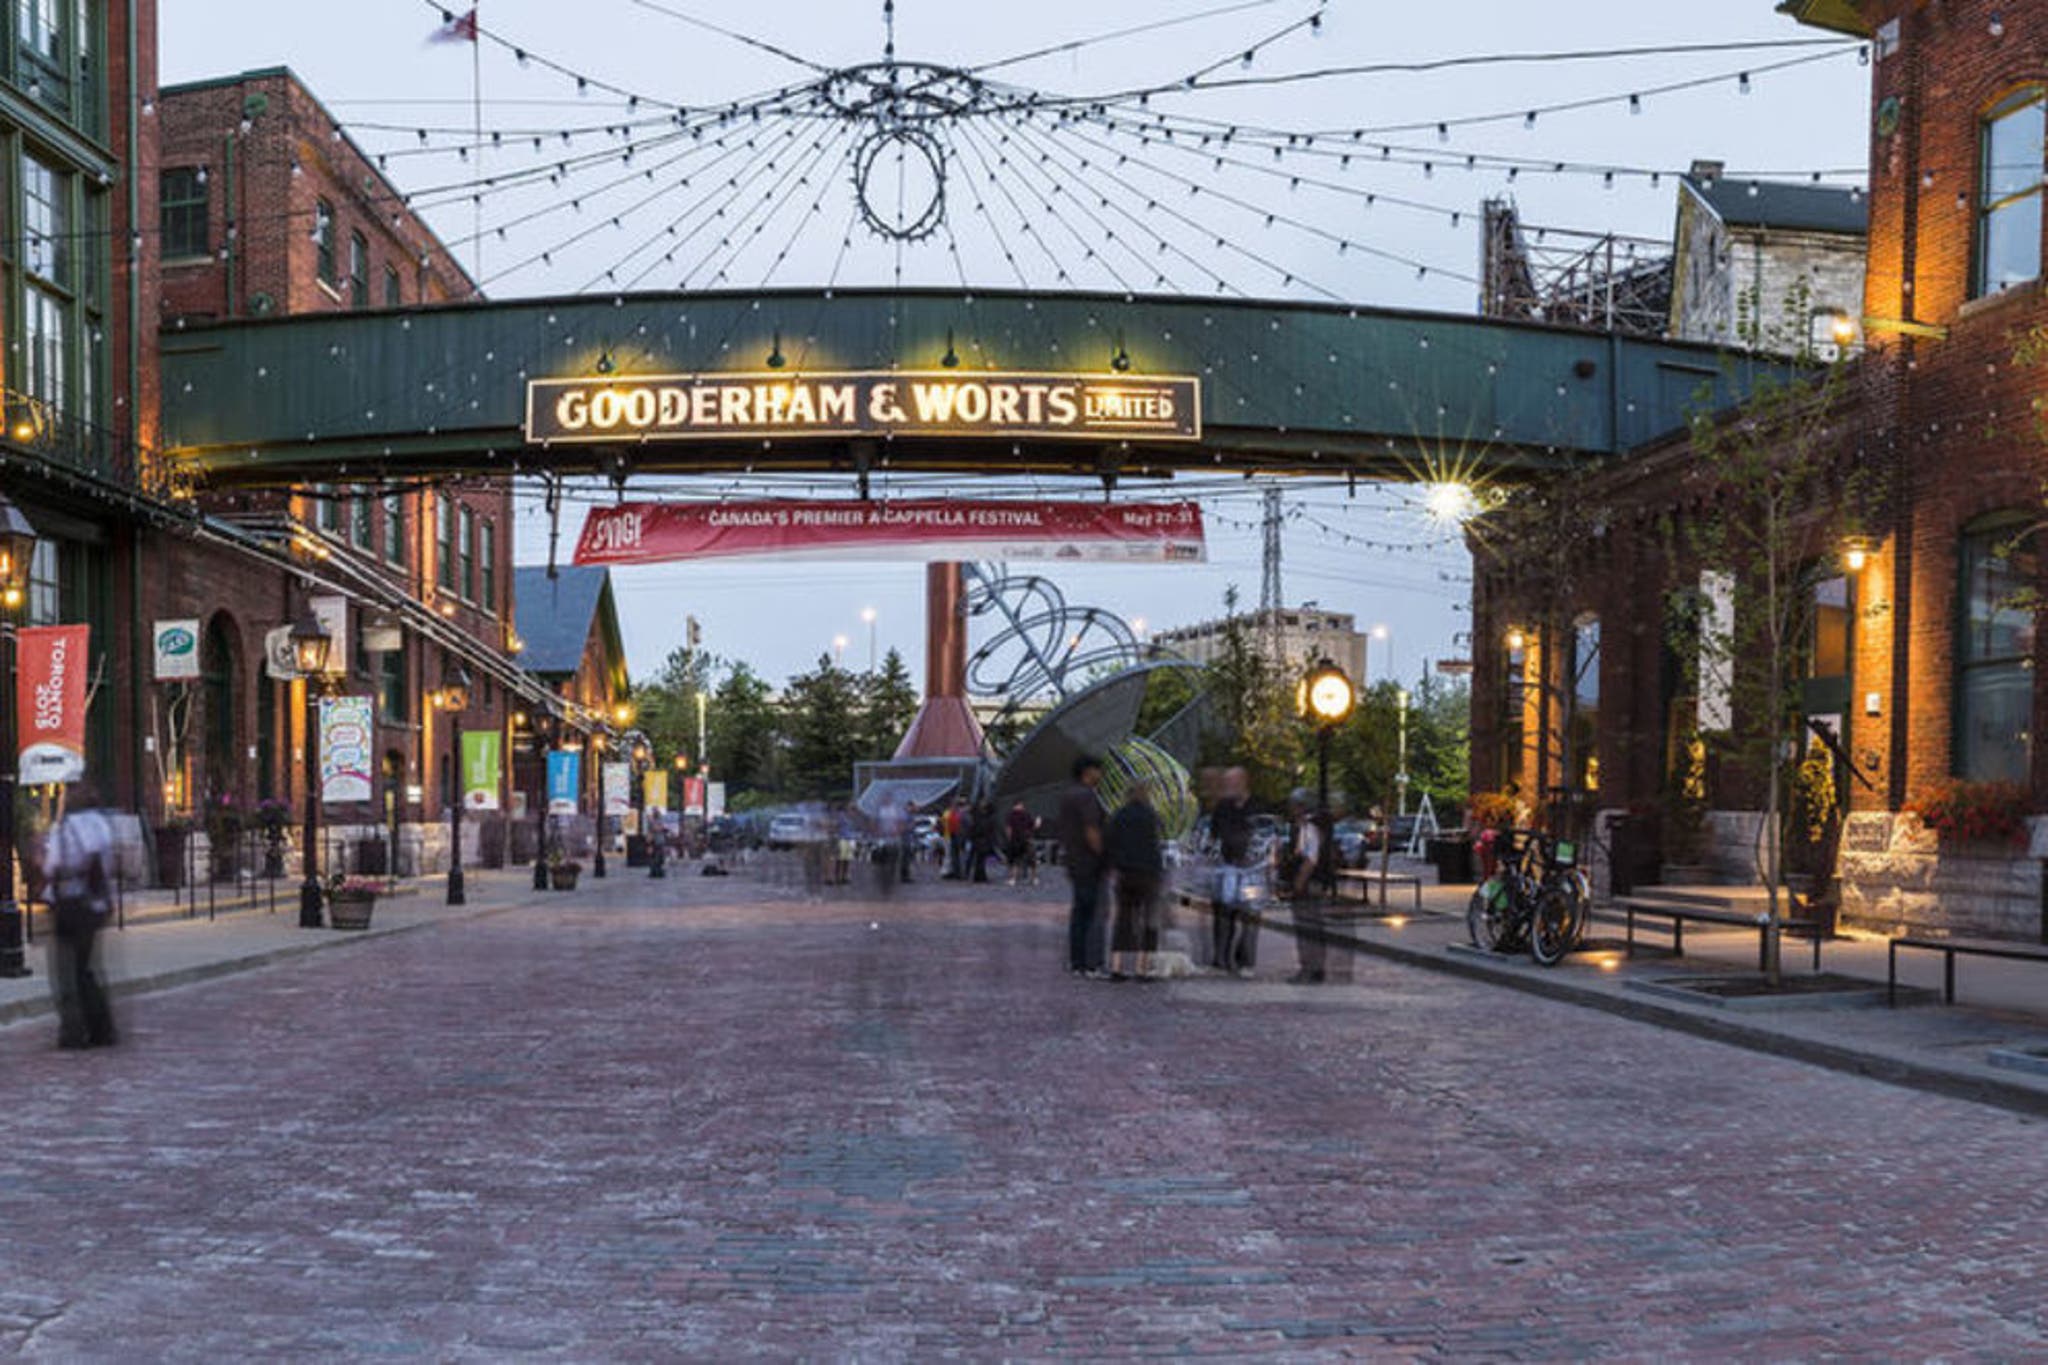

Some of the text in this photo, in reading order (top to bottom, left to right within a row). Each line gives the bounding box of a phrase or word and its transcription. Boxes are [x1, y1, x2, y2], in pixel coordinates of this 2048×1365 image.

[556, 383, 1174, 429] GOODERHAM & WORTS LIMITED
[708, 510, 789, 527] CANADA'S
[792, 510, 864, 526] PREMIER
[883, 509, 965, 526] CAPPELLA
[968, 510, 1043, 526] FESTIVAL
[1123, 511, 1153, 528] May
[49, 635, 67, 729] TORONTO
[35, 682, 50, 730] 2015
